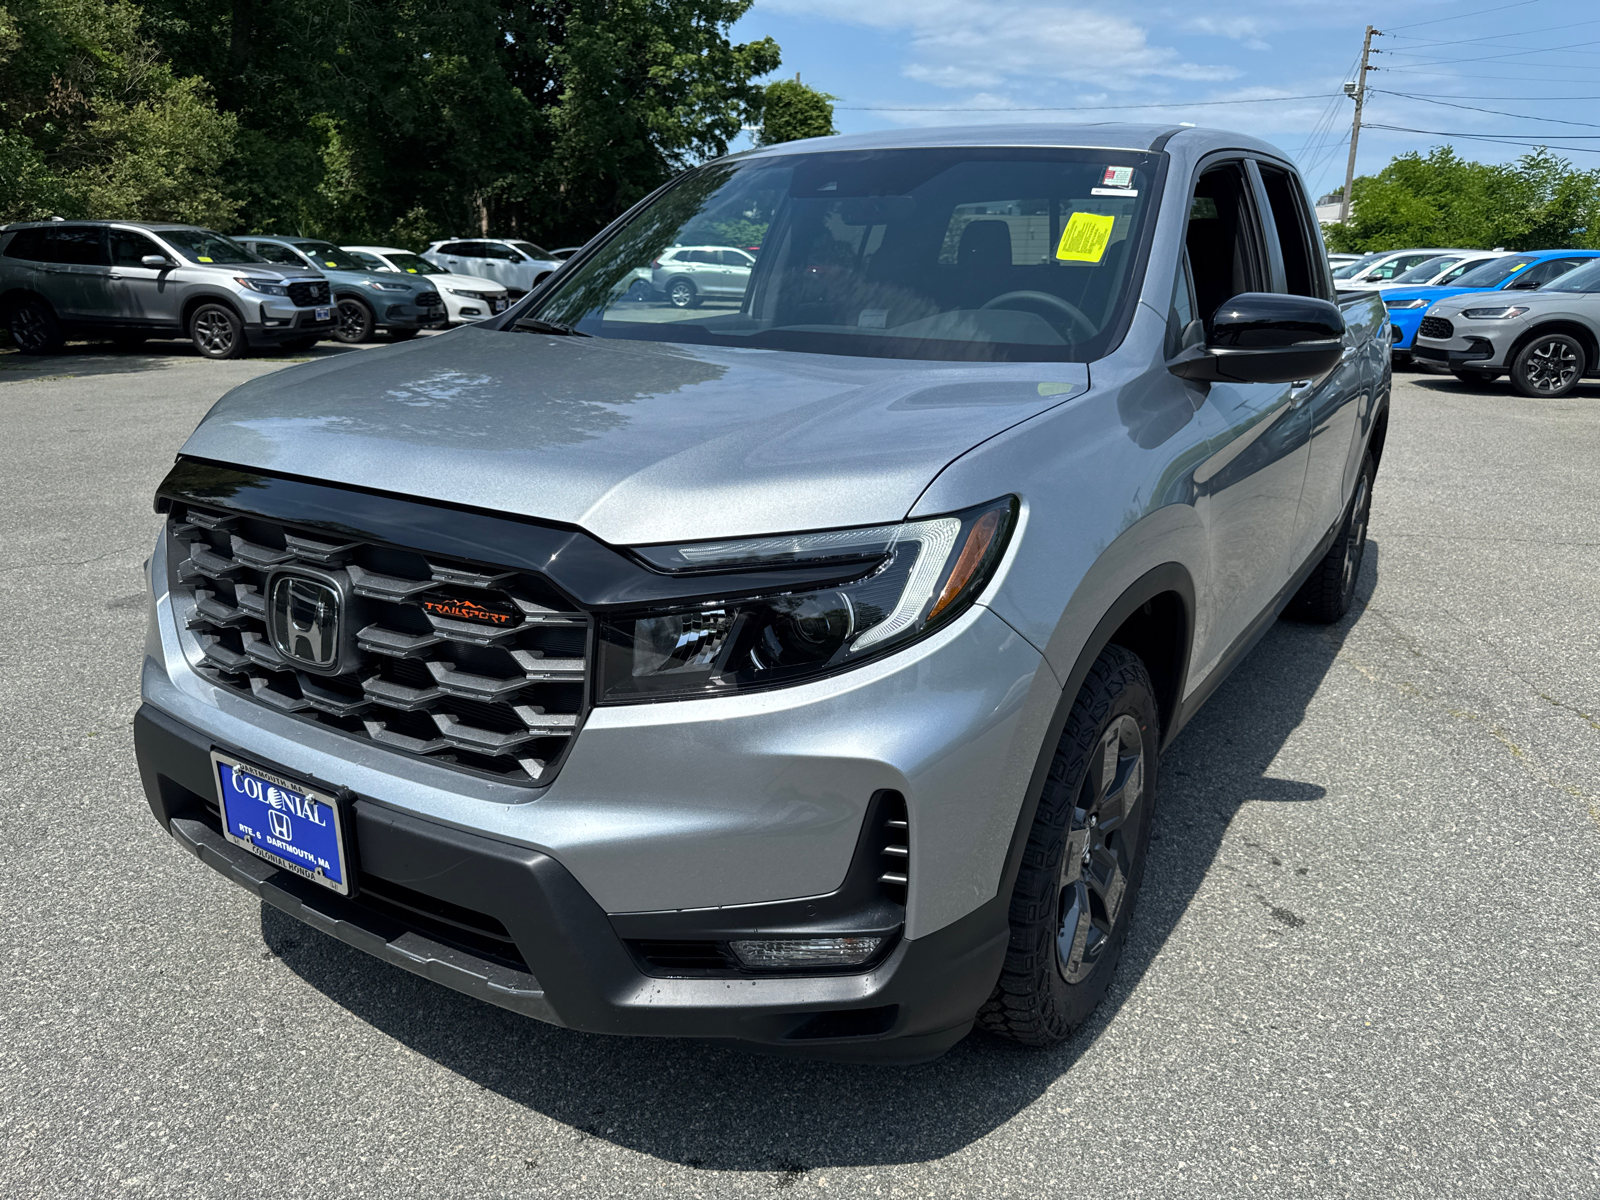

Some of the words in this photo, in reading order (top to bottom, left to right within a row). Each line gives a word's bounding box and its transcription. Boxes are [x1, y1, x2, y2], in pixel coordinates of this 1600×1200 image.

[425, 602, 509, 623] TRAILSPORT
[232, 770, 326, 827] COLONIAL
[239, 823, 255, 837] RTE.
[256, 831, 262, 840] 6
[266, 835, 317, 865] DARTMOUTH,
[317, 857, 331, 870] MA
[252, 846, 288, 869] COLONIAL
[288, 862, 316, 881] HONDA
